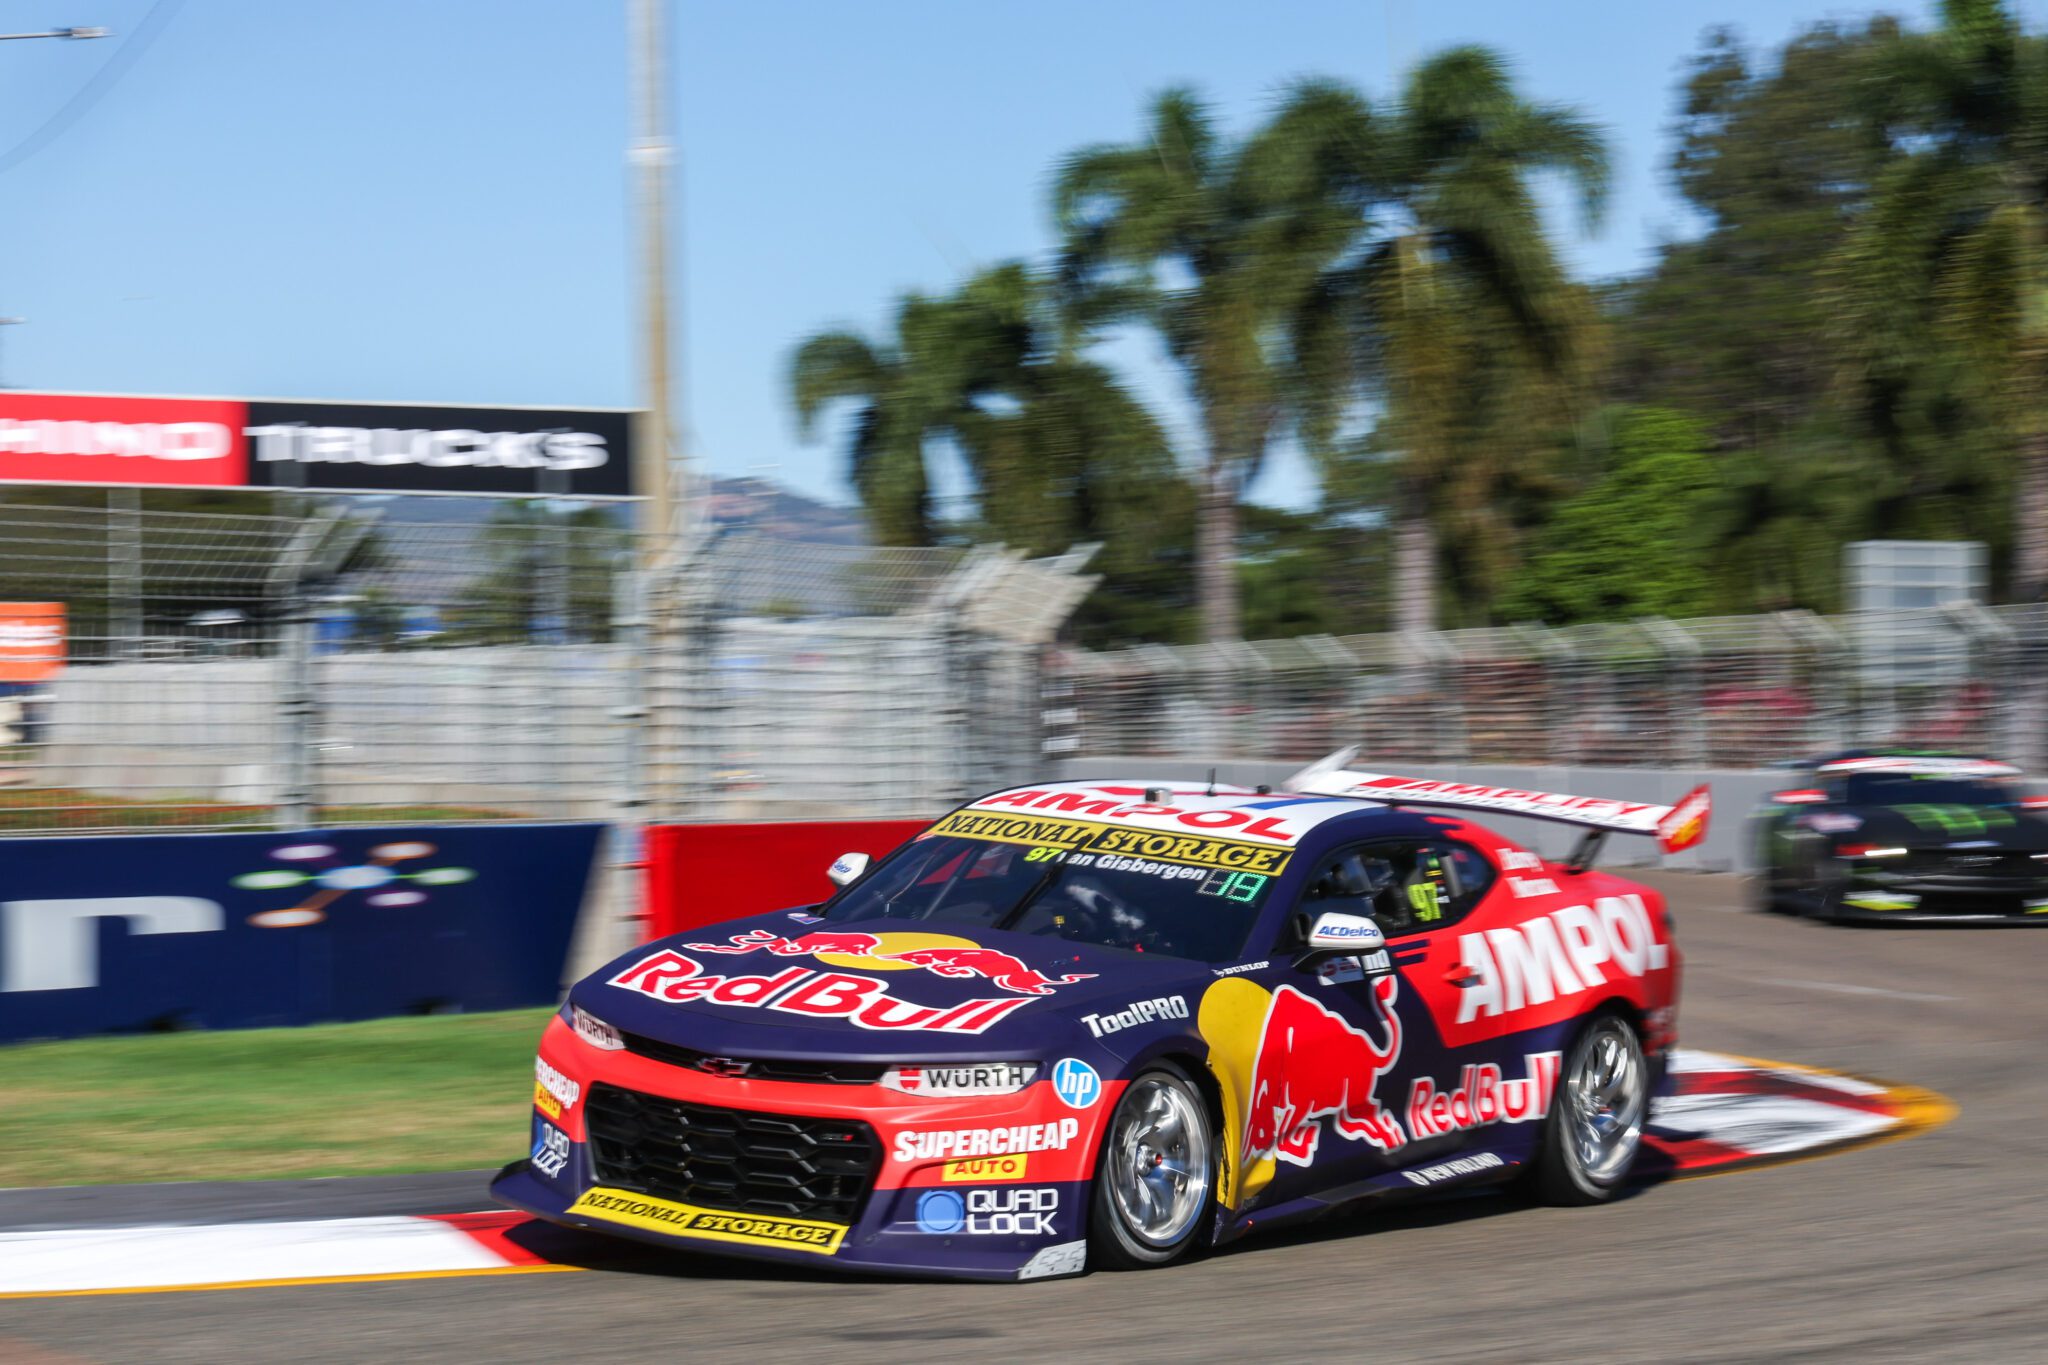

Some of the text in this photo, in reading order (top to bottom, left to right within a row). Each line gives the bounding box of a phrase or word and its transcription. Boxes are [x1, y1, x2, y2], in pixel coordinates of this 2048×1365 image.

[242, 423, 610, 471] TRUCKS
[978, 790, 1297, 841] AMPOL
[1398, 779, 1652, 815] AMPLIFY
[940, 814, 1280, 870] NATIONAL STORAGE
[1023, 846, 1064, 863] 97
[1094, 854, 1208, 881] Gisbergen
[1407, 883, 1441, 922] 97
[1317, 925, 1379, 937] ACDelco
[1222, 961, 1270, 975] DUNLOP
[1455, 894, 1669, 1025] AMPOL
[1080, 994, 1190, 1038] ToolPRO
[538, 1089, 559, 1114] AUTO
[1061, 1059, 1094, 1107] hp
[542, 1122, 570, 1159] QUAD
[893, 1117, 1079, 1162] SUPERCHEAP
[531, 1145, 568, 1179] LOCK
[953, 1159, 1017, 1175] AUTO
[580, 1192, 832, 1244] NATIONAL STORAGE
[966, 1188, 1059, 1213] QUAD
[966, 1211, 1058, 1235] LOCK
